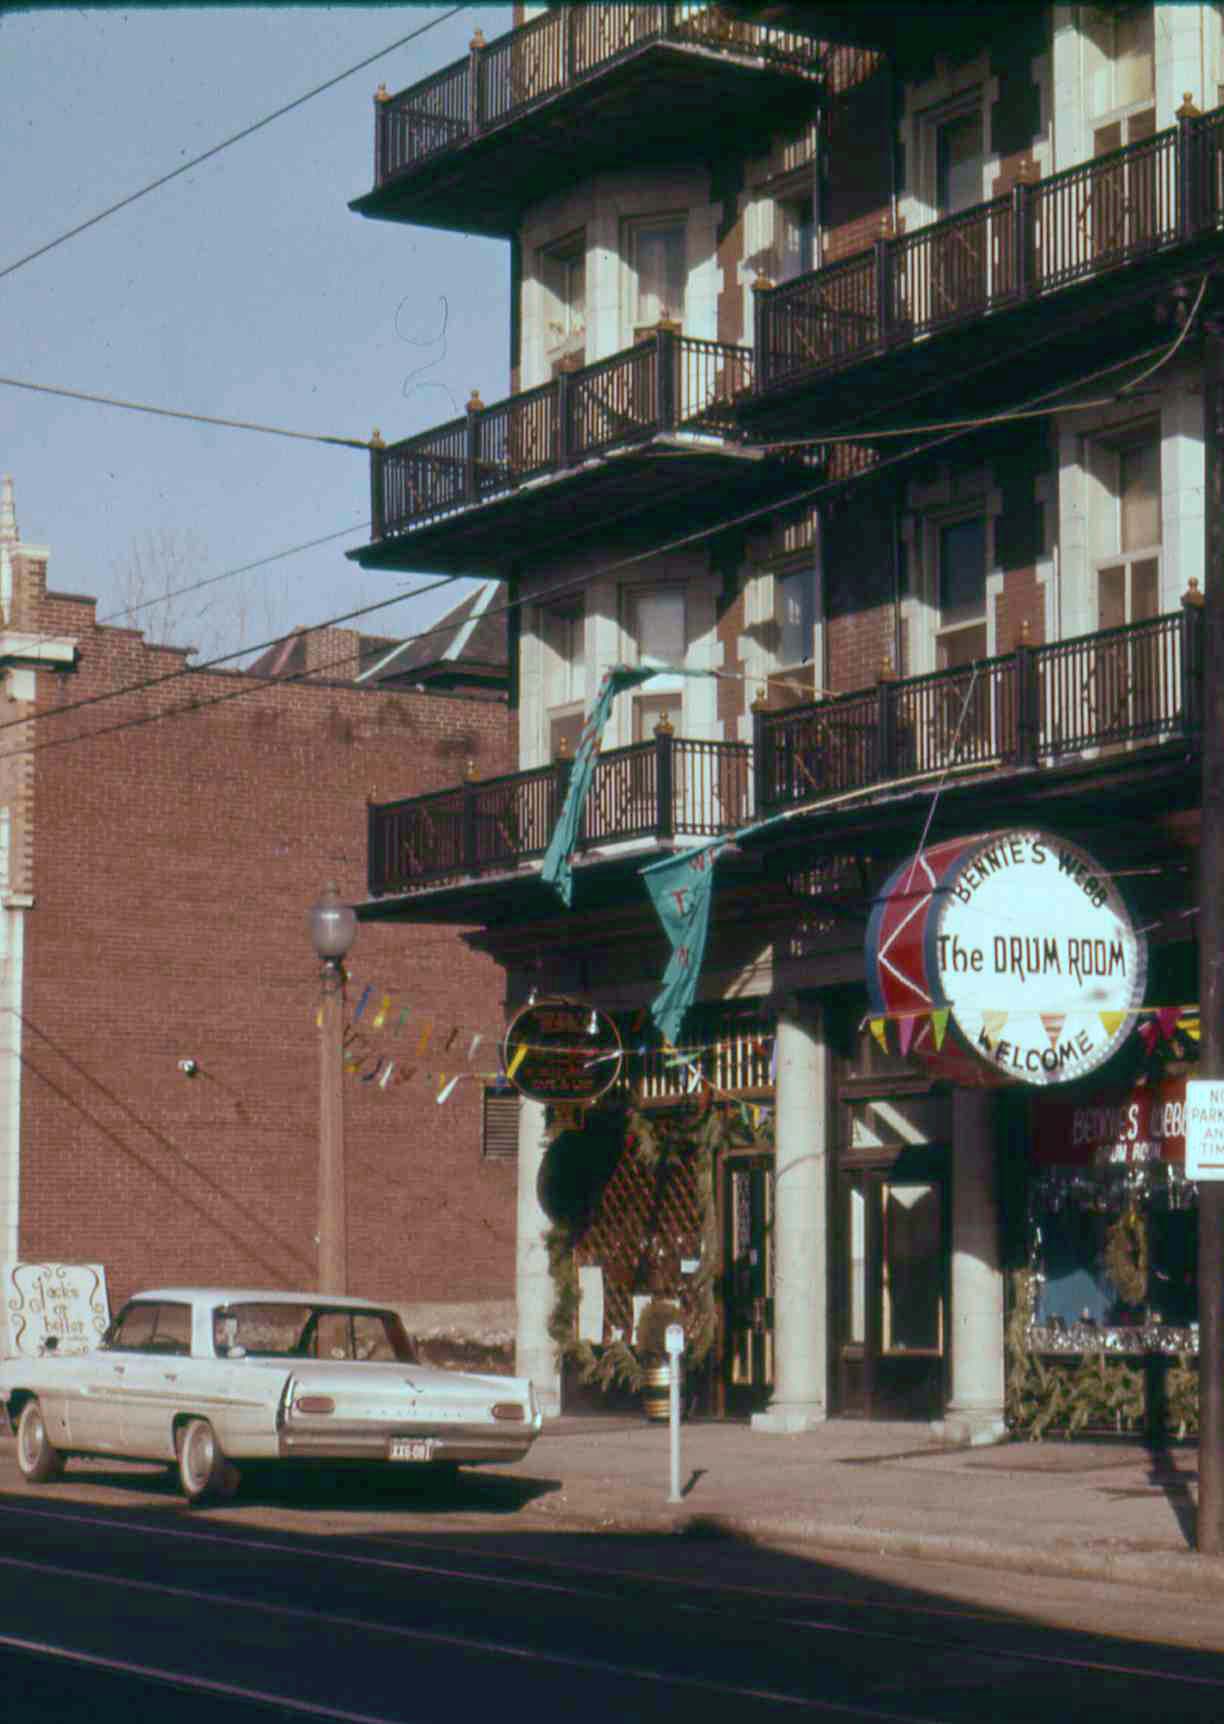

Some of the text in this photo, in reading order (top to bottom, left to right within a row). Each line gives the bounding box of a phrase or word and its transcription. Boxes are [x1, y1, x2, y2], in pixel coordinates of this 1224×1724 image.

[951, 839, 1110, 909] BENNIE'S WEBB
[937, 934, 1126, 987] The DRUM ROOM
